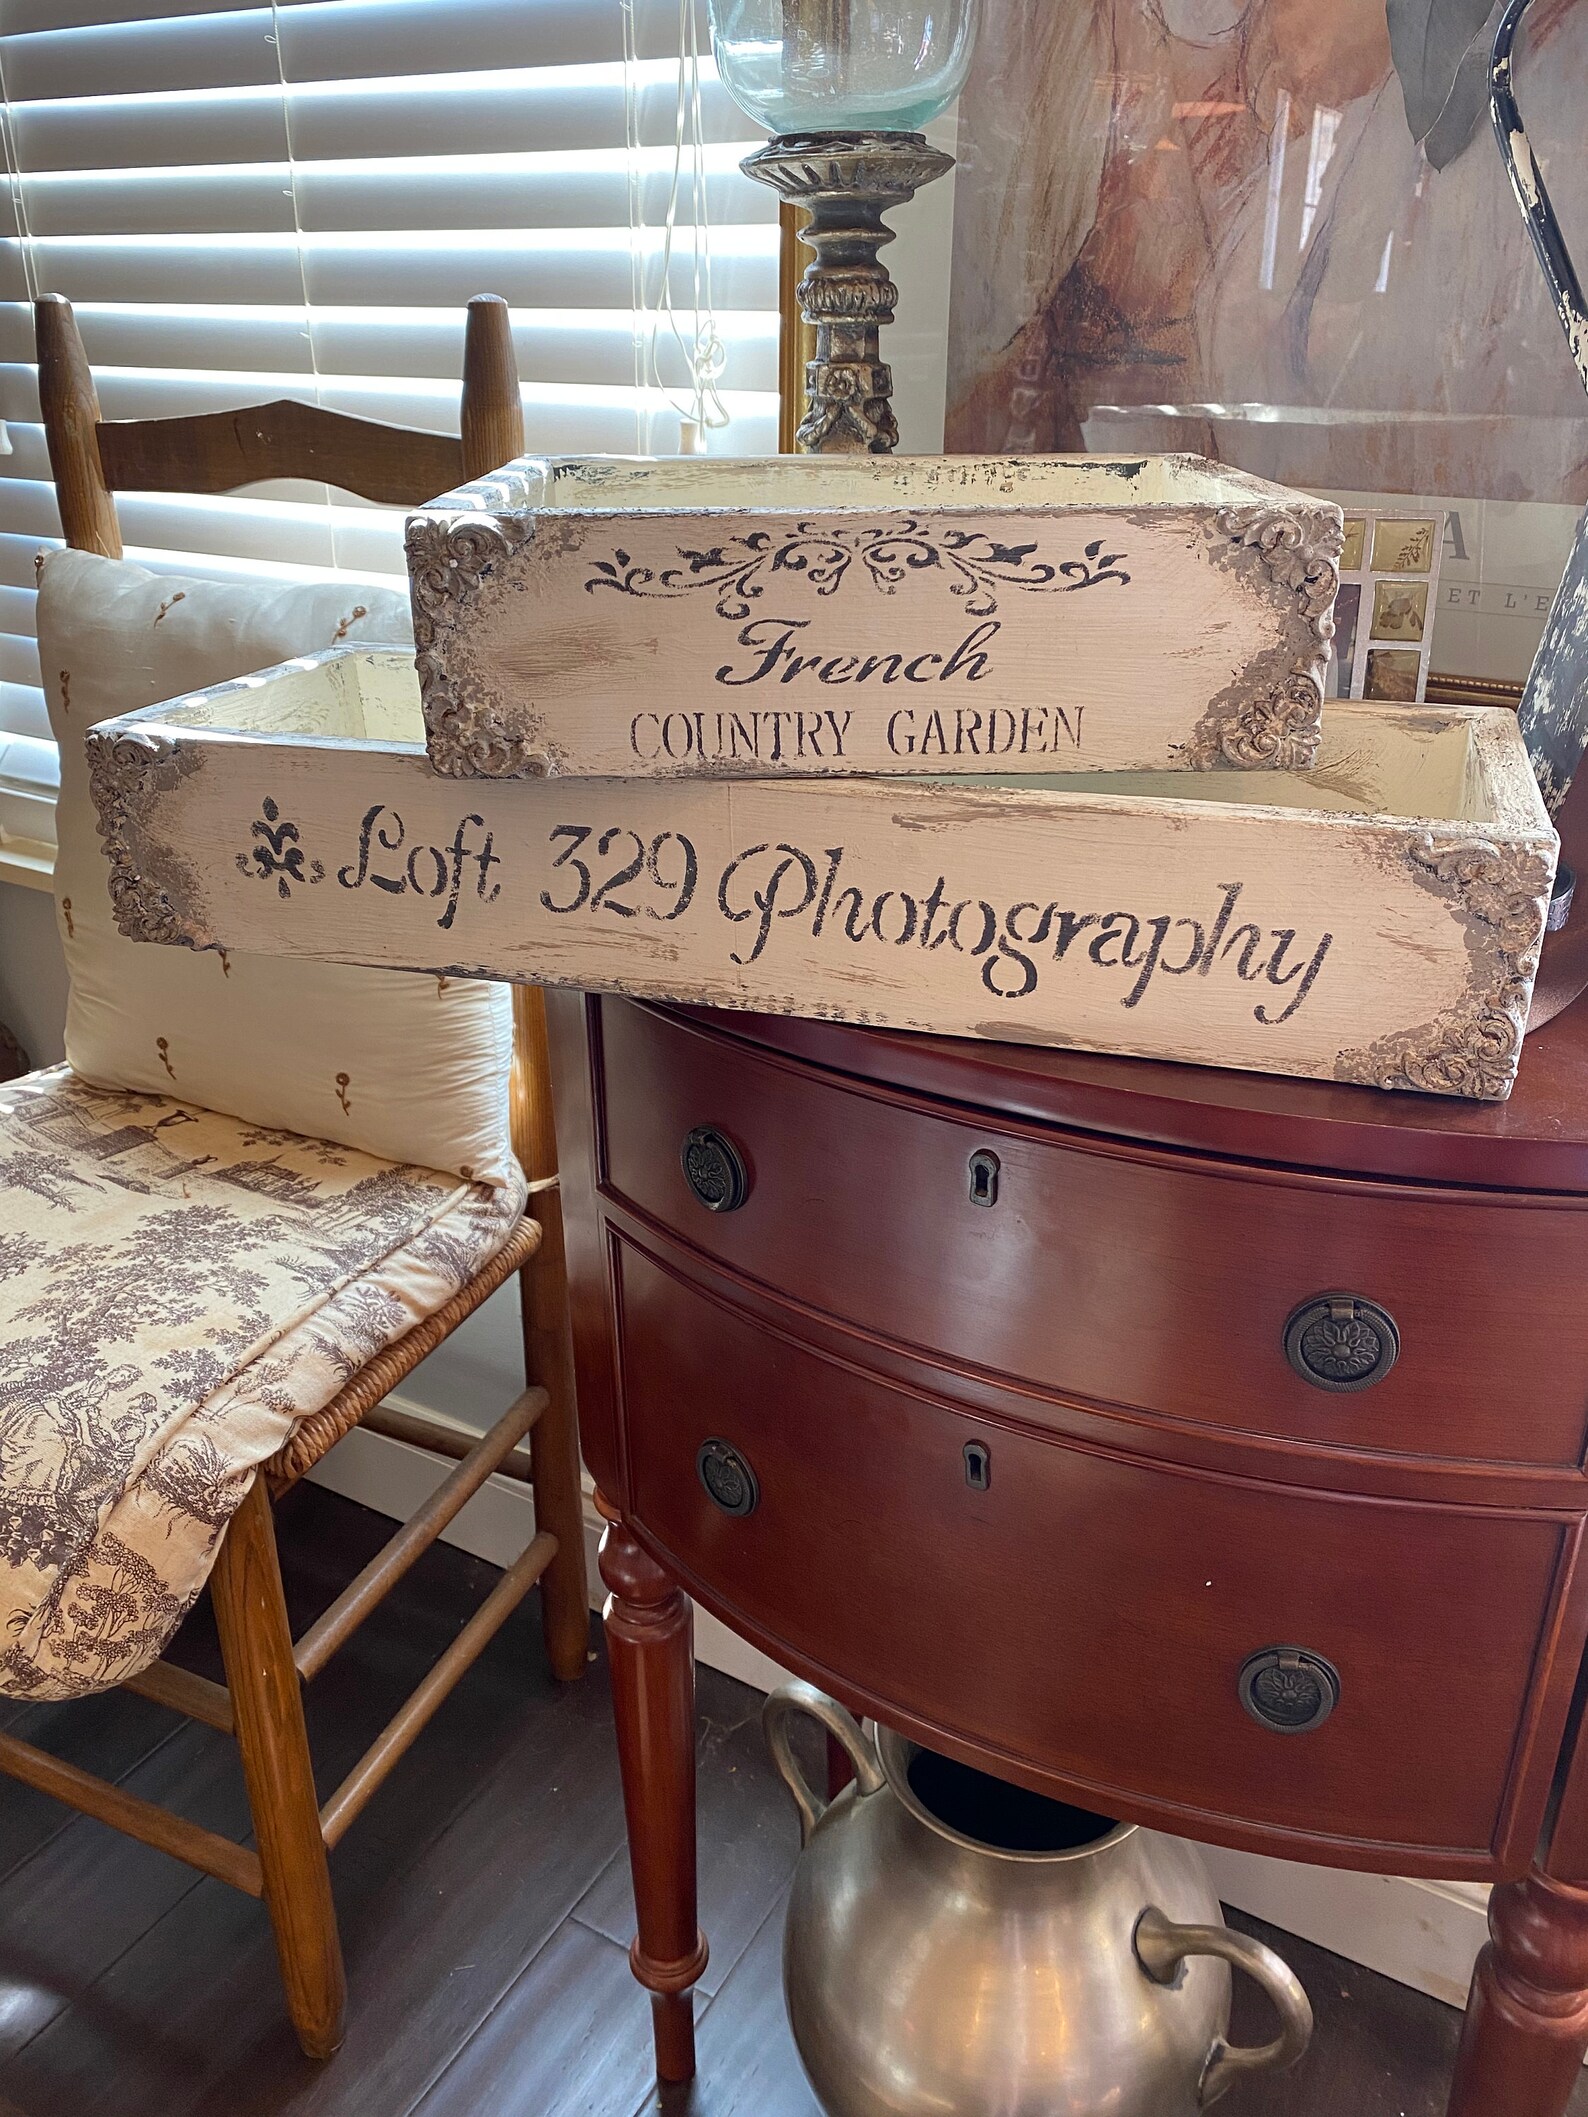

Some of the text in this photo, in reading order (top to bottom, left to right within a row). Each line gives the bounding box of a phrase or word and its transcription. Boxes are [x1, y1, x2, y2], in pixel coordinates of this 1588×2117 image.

[1448, 587, 1480, 605] ET
[715, 619, 1002, 686] French
[630, 705, 1086, 760] COUNTRY GARDEN
[337, 804, 1334, 1026] Loft 329 Photography
